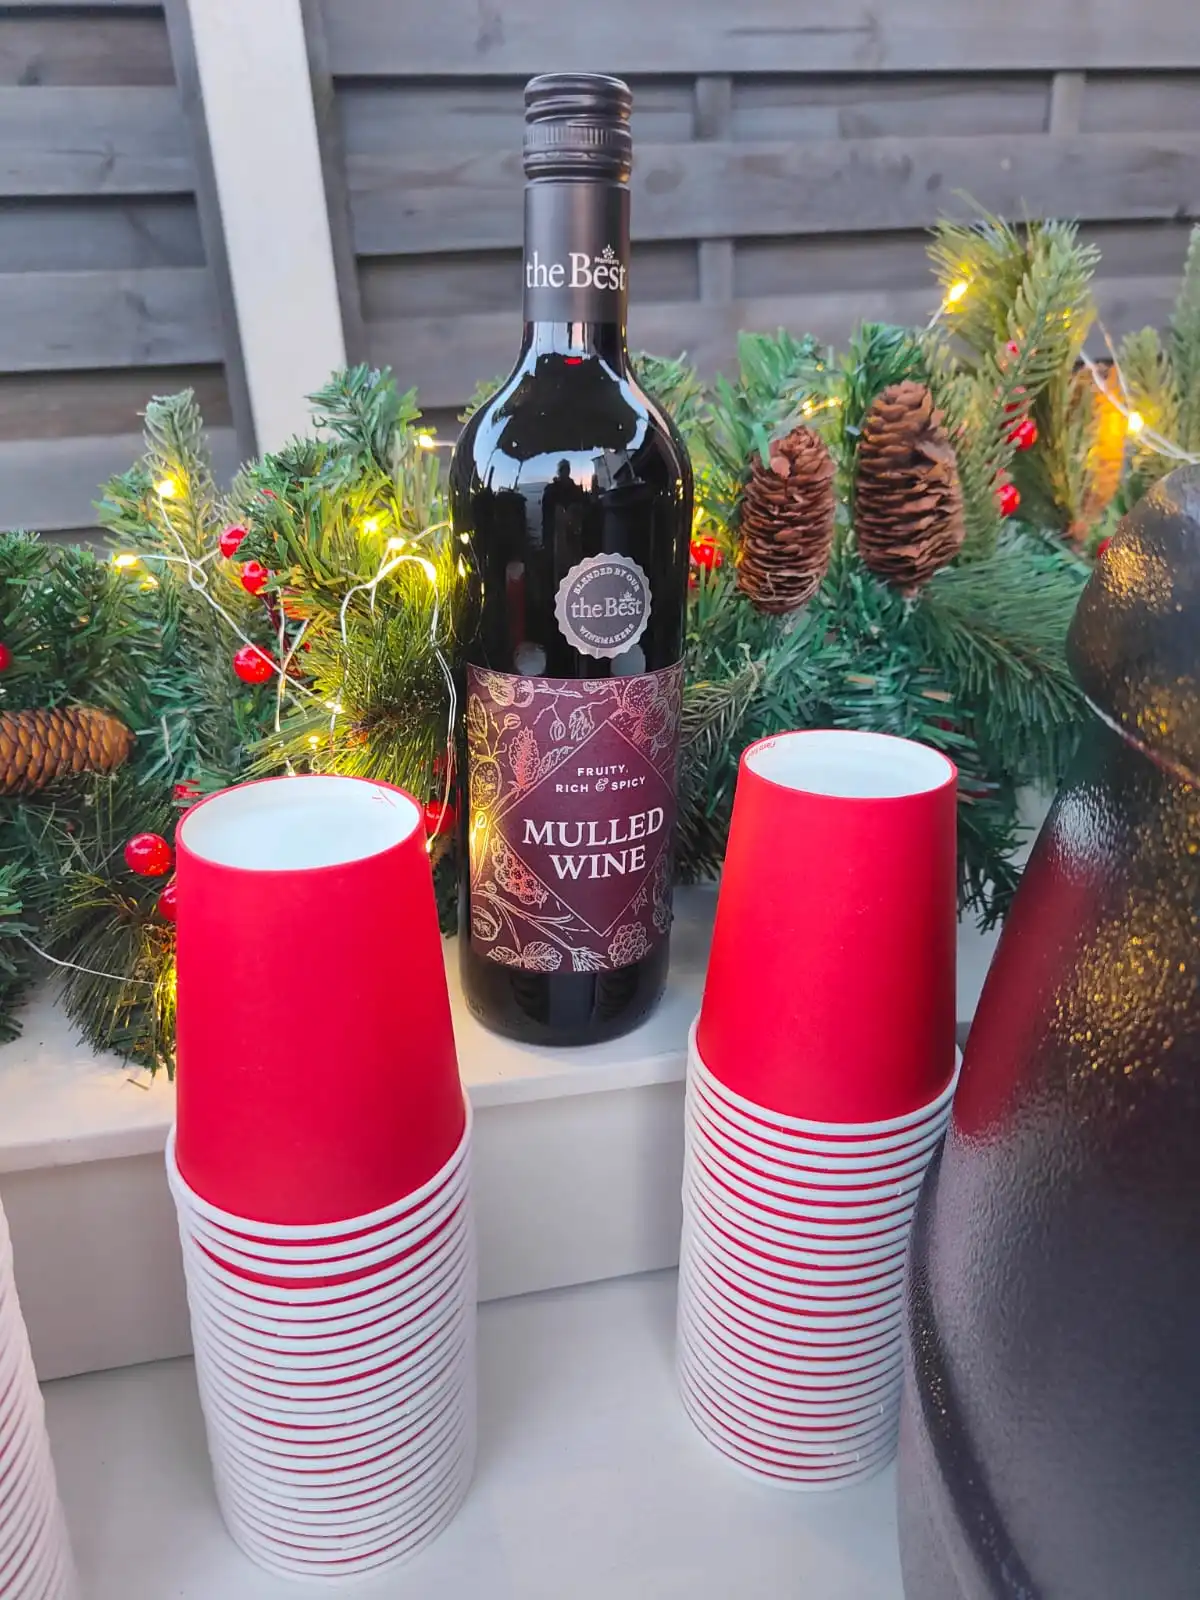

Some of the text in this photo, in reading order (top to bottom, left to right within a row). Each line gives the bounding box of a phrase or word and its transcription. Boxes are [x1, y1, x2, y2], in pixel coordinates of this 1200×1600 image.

[526, 250, 625, 291] the Best
[574, 567, 641, 595] BLENDED BY OUR
[571, 597, 642, 618] the Best
[579, 623, 635, 645] WINEMAKERS
[555, 776, 646, 793] RICH & SPICY
[522, 807, 664, 847] MULLED
[549, 845, 646, 880] WINE
